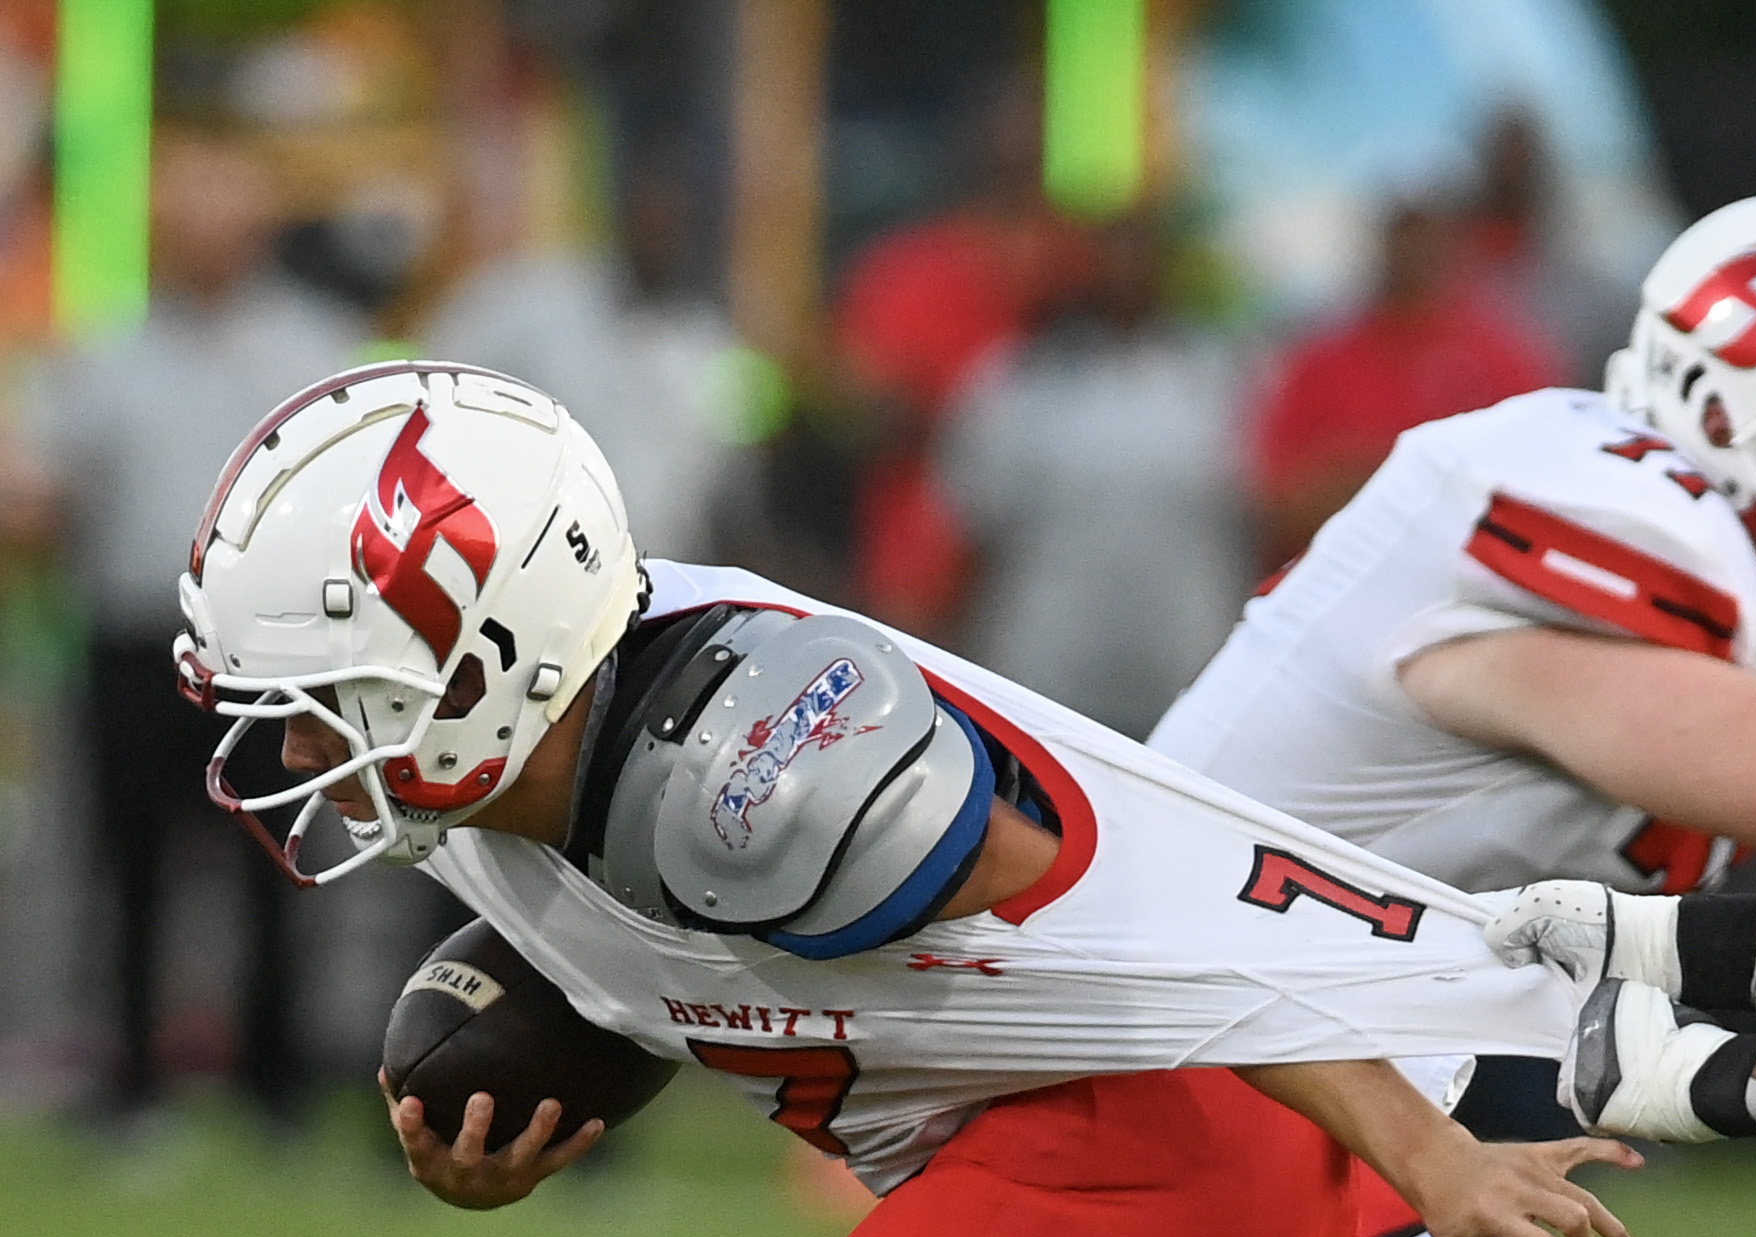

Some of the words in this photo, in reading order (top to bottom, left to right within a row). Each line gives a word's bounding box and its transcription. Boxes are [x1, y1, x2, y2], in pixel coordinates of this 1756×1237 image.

[1237, 844, 1427, 943] 7
[427, 965, 482, 995] HTHS
[659, 996, 854, 1040] HEWITT
[686, 1037, 861, 1156] 7
